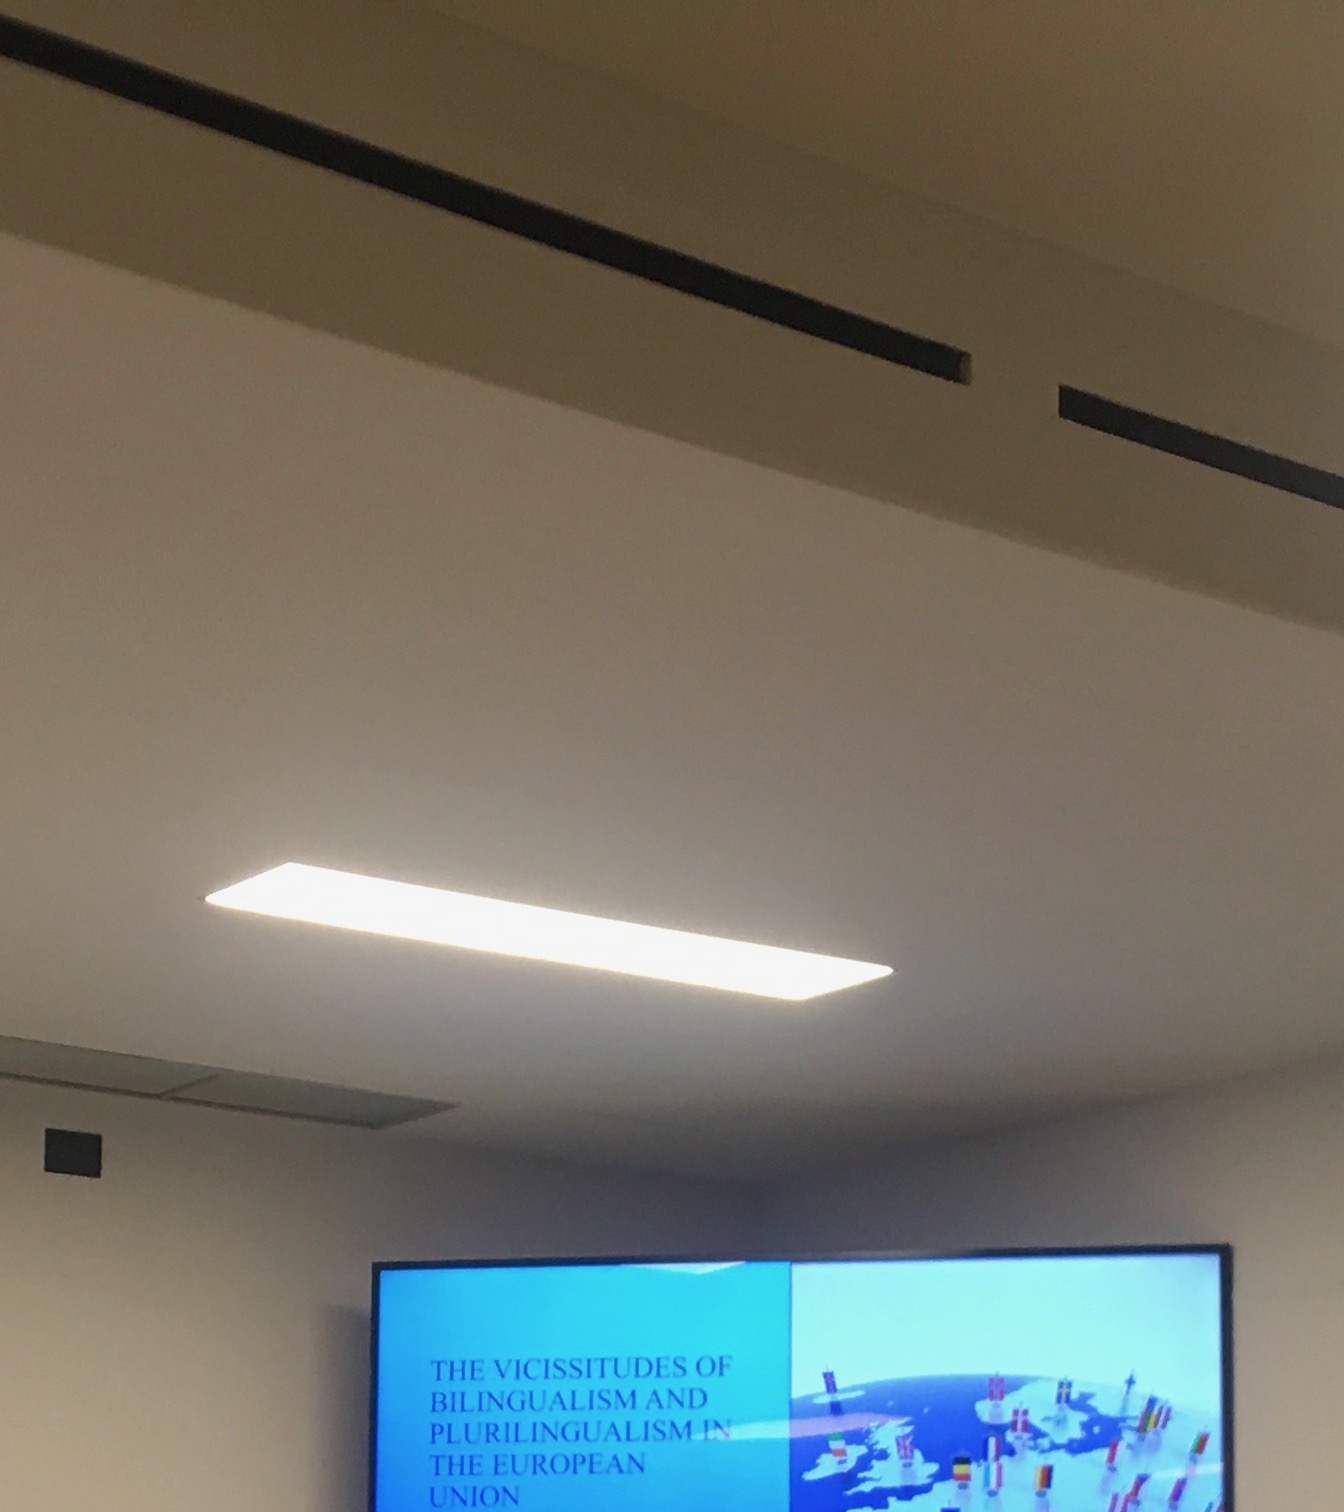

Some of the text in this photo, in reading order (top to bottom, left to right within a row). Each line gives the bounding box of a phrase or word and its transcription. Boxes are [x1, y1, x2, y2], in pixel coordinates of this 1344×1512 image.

[430, 1354, 734, 1382] THE VICISSITUDES OF
[430, 1387, 709, 1414] BILINGUALISM AND
[429, 1418, 734, 1444] PLURILINGUALISM IN
[429, 1452, 647, 1477] THE EUROPEAN
[429, 1485, 521, 1509] UNION
